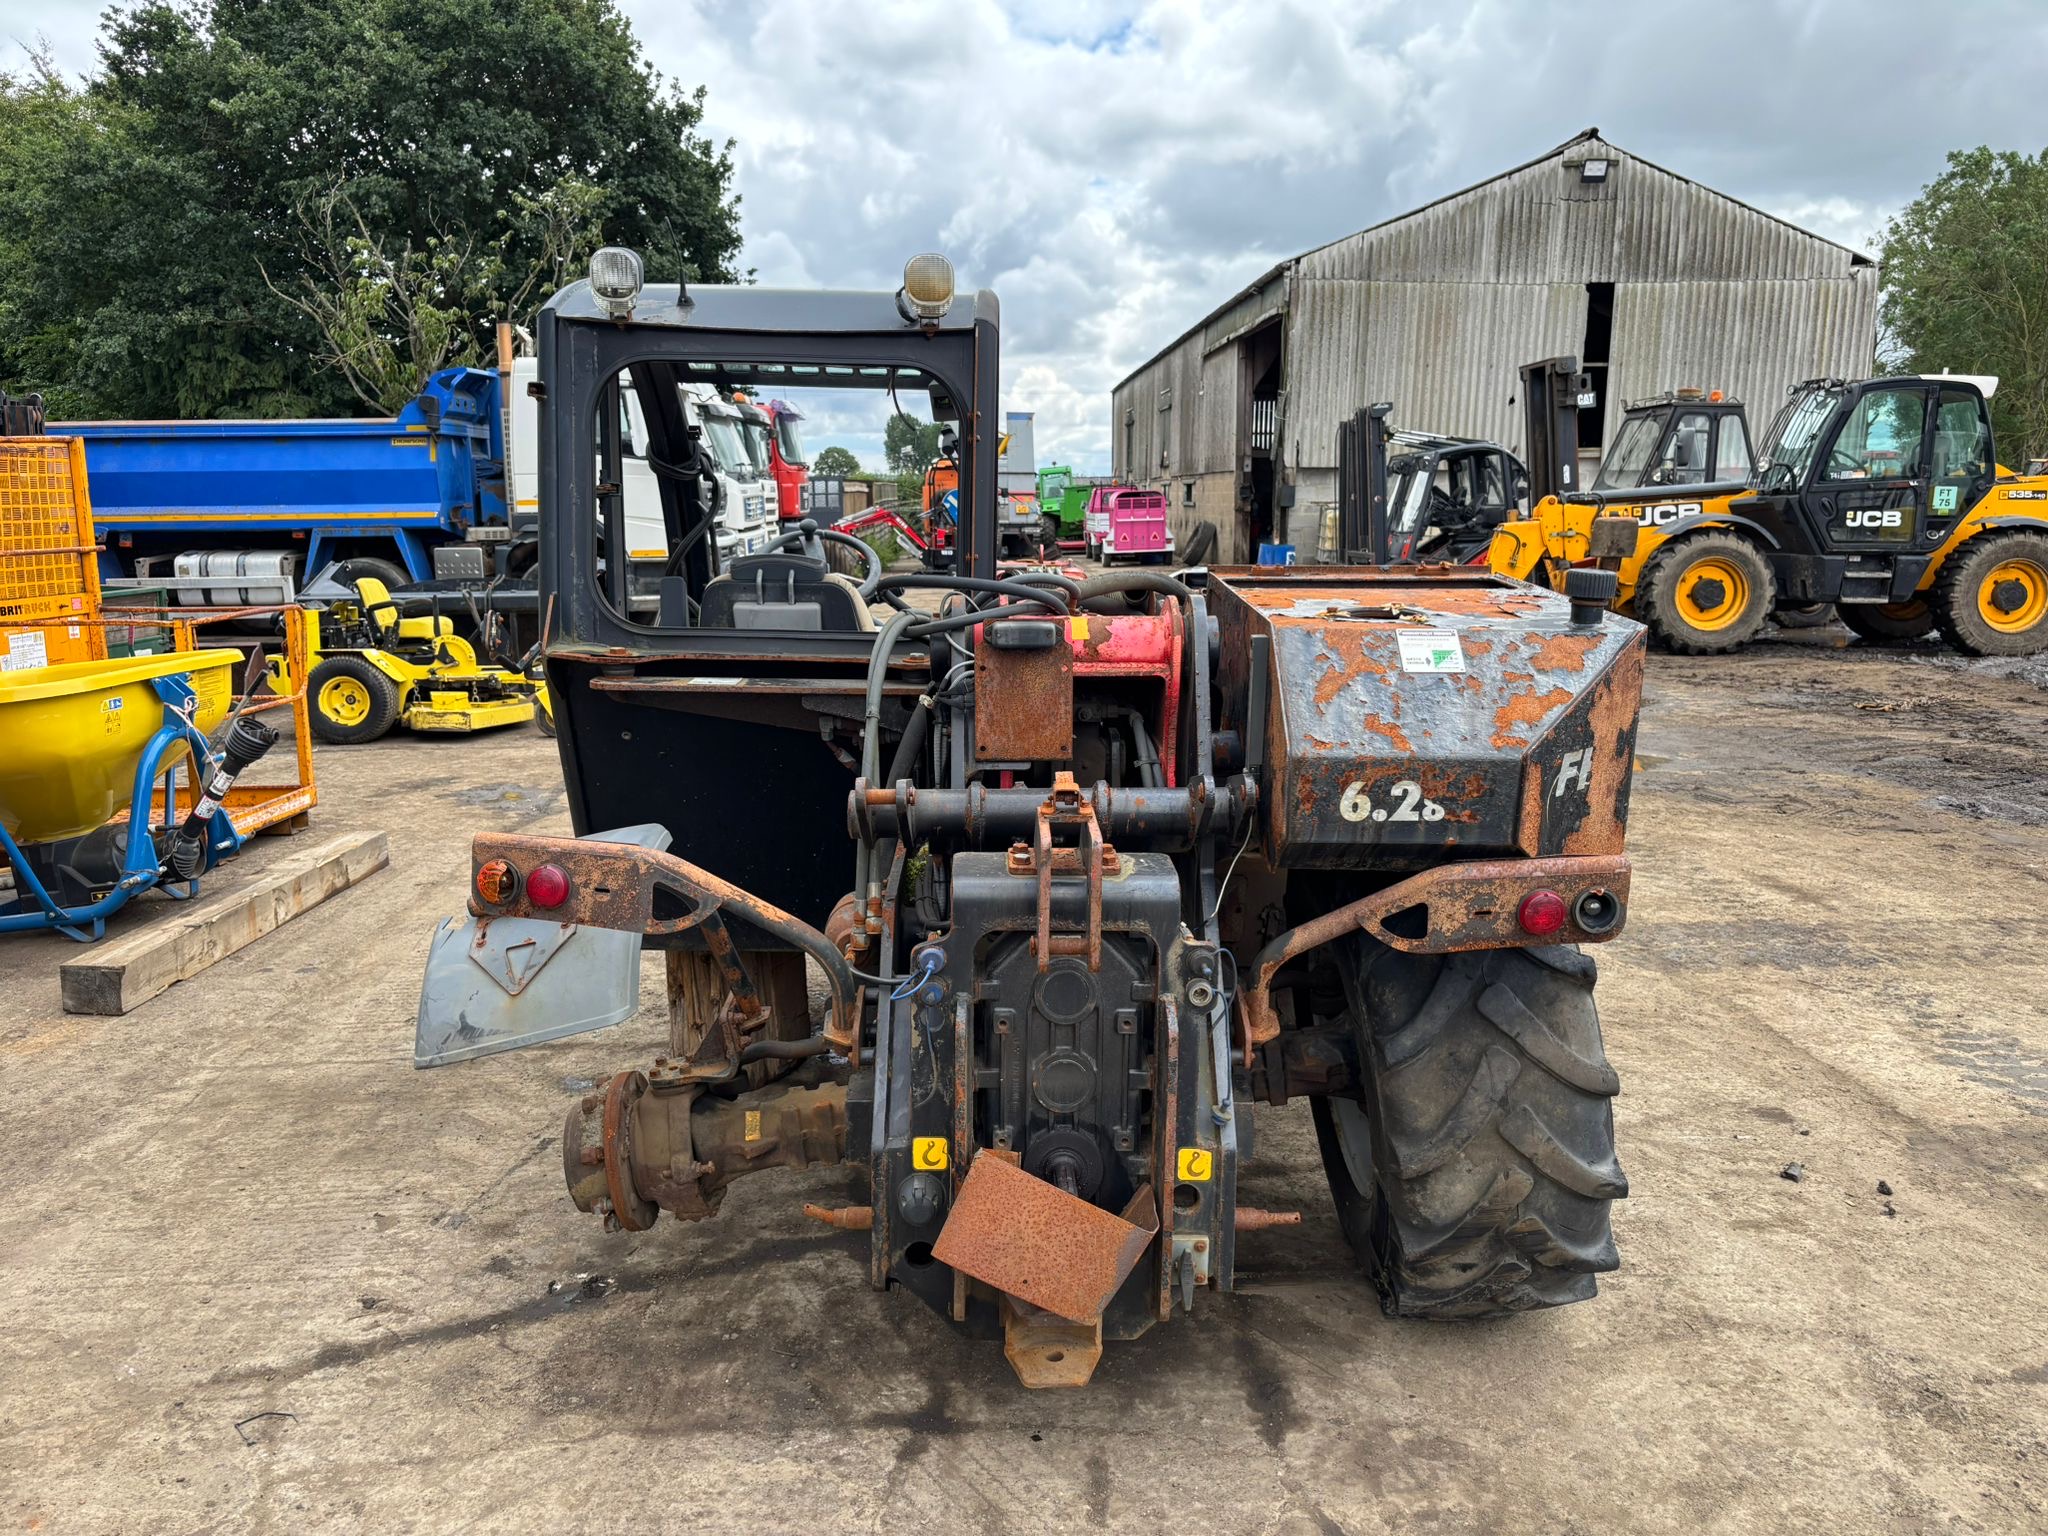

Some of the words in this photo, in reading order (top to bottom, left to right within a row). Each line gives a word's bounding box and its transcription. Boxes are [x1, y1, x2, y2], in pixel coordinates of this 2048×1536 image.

[1577, 393, 1594, 405] CAT
[1939, 489, 1952, 497] FT
[1939, 499, 1951, 507] 75
[1637, 503, 1701, 527] JCB
[1846, 511, 1902, 527] JCB
